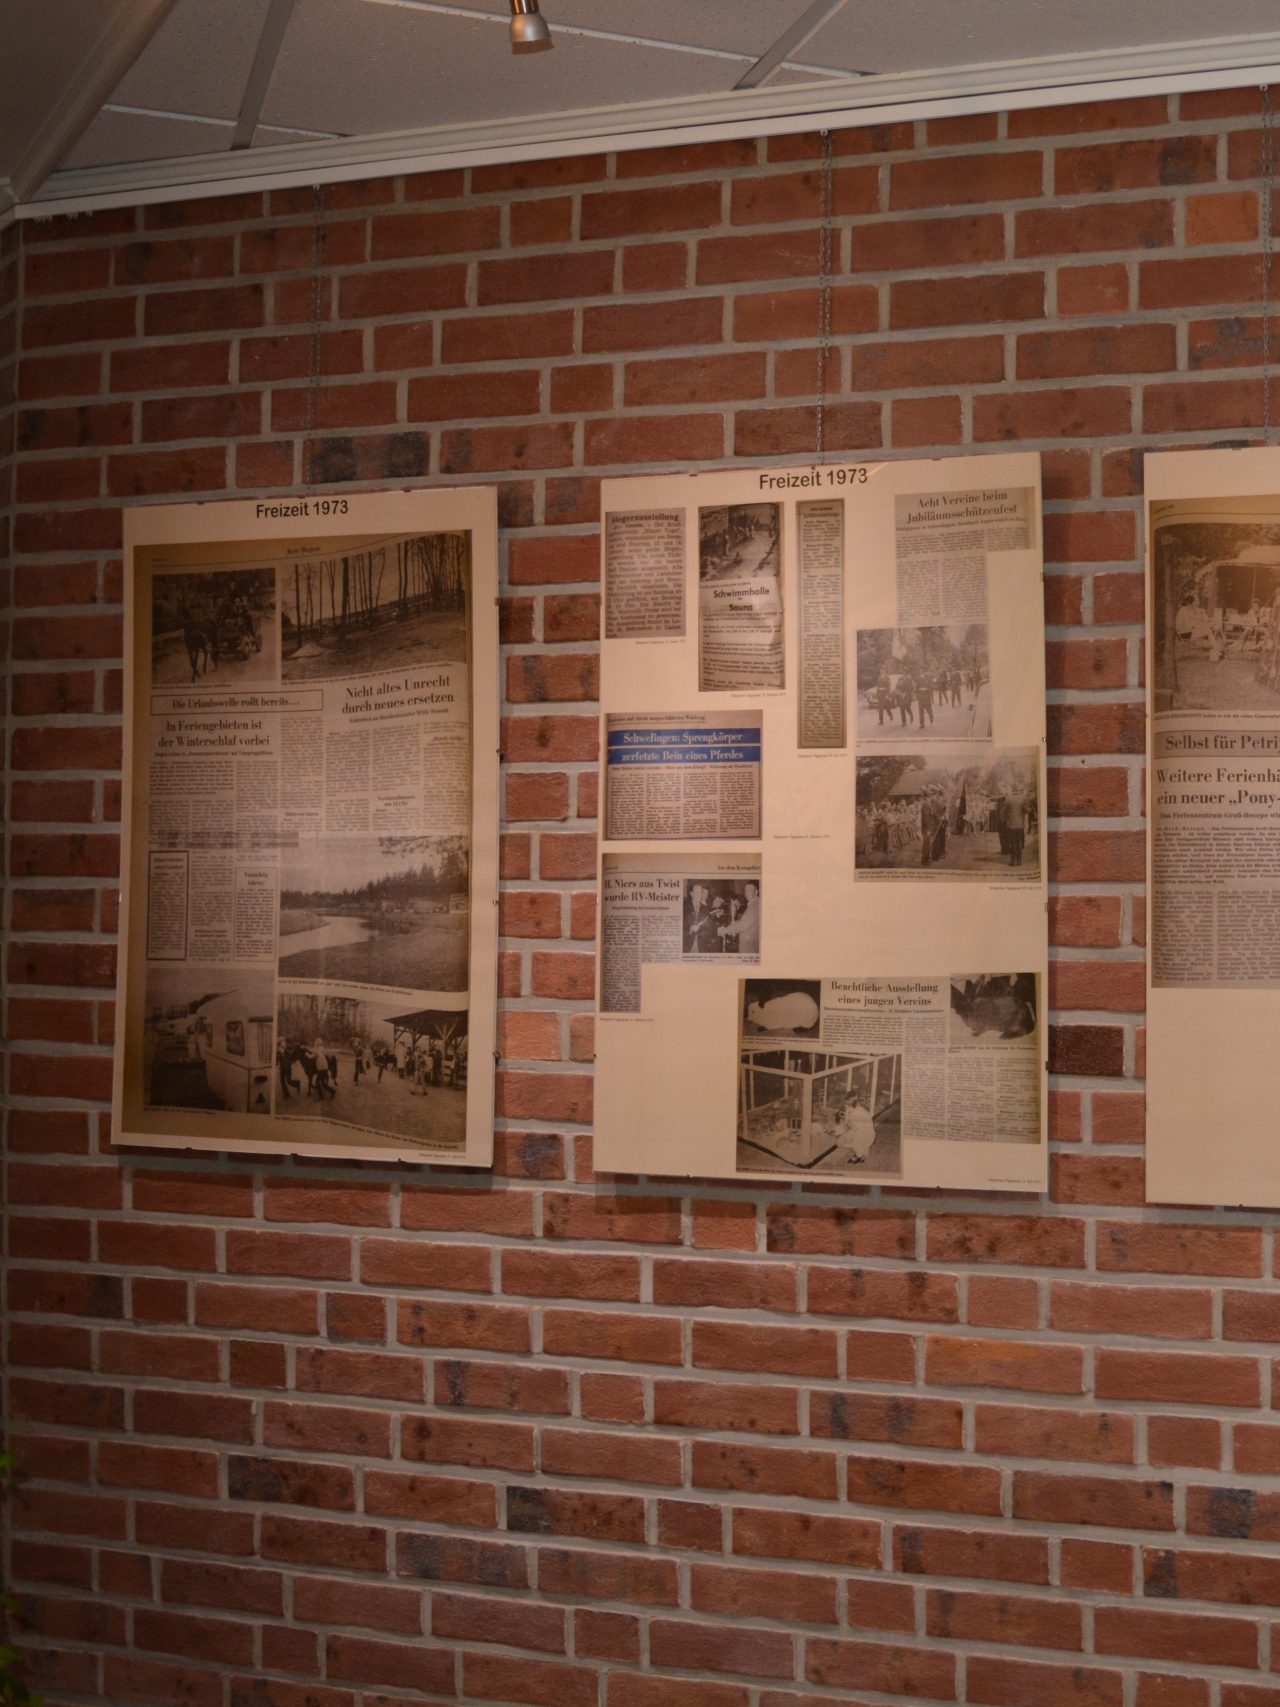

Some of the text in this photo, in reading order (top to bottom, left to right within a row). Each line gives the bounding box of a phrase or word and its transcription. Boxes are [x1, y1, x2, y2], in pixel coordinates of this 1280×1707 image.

[759, 468, 868, 490] Freizeit 1973
[919, 490, 1008, 509] Acht Vereine beim
[256, 500, 349, 519] Freizeit 1973
[906, 504, 1017, 524] Jubiläumsschützenfest
[713, 587, 770, 599] Schwimmhalle
[729, 604, 753, 612] Sauna
[345, 675, 451, 699] Nicht altes Unrecht
[342, 693, 454, 714] durch neues ersetzen
[167, 719, 262, 733] In Feriengebieten ist
[158, 735, 270, 747] der Winterschlaf vorbei
[623, 731, 743, 745] Schwefingen: Sprengkörper
[1165, 735, 1209, 750] Selbst
[1213, 734, 1236, 750] für
[622, 750, 744, 761] zerfetzte Bein eines Pferdes
[1157, 769, 1212, 784] Weitere
[1157, 790, 1177, 805] ein
[1181, 792, 1225, 804] neuer
[614, 879, 637, 888] Niers
[639, 880, 653, 888] aus
[656, 879, 680, 888] Twist
[631, 892, 680, 902] RV-Meister
[831, 981, 940, 995] Beachtliche Ausstellung
[838, 994, 932, 1007] eines jungen Vereins
